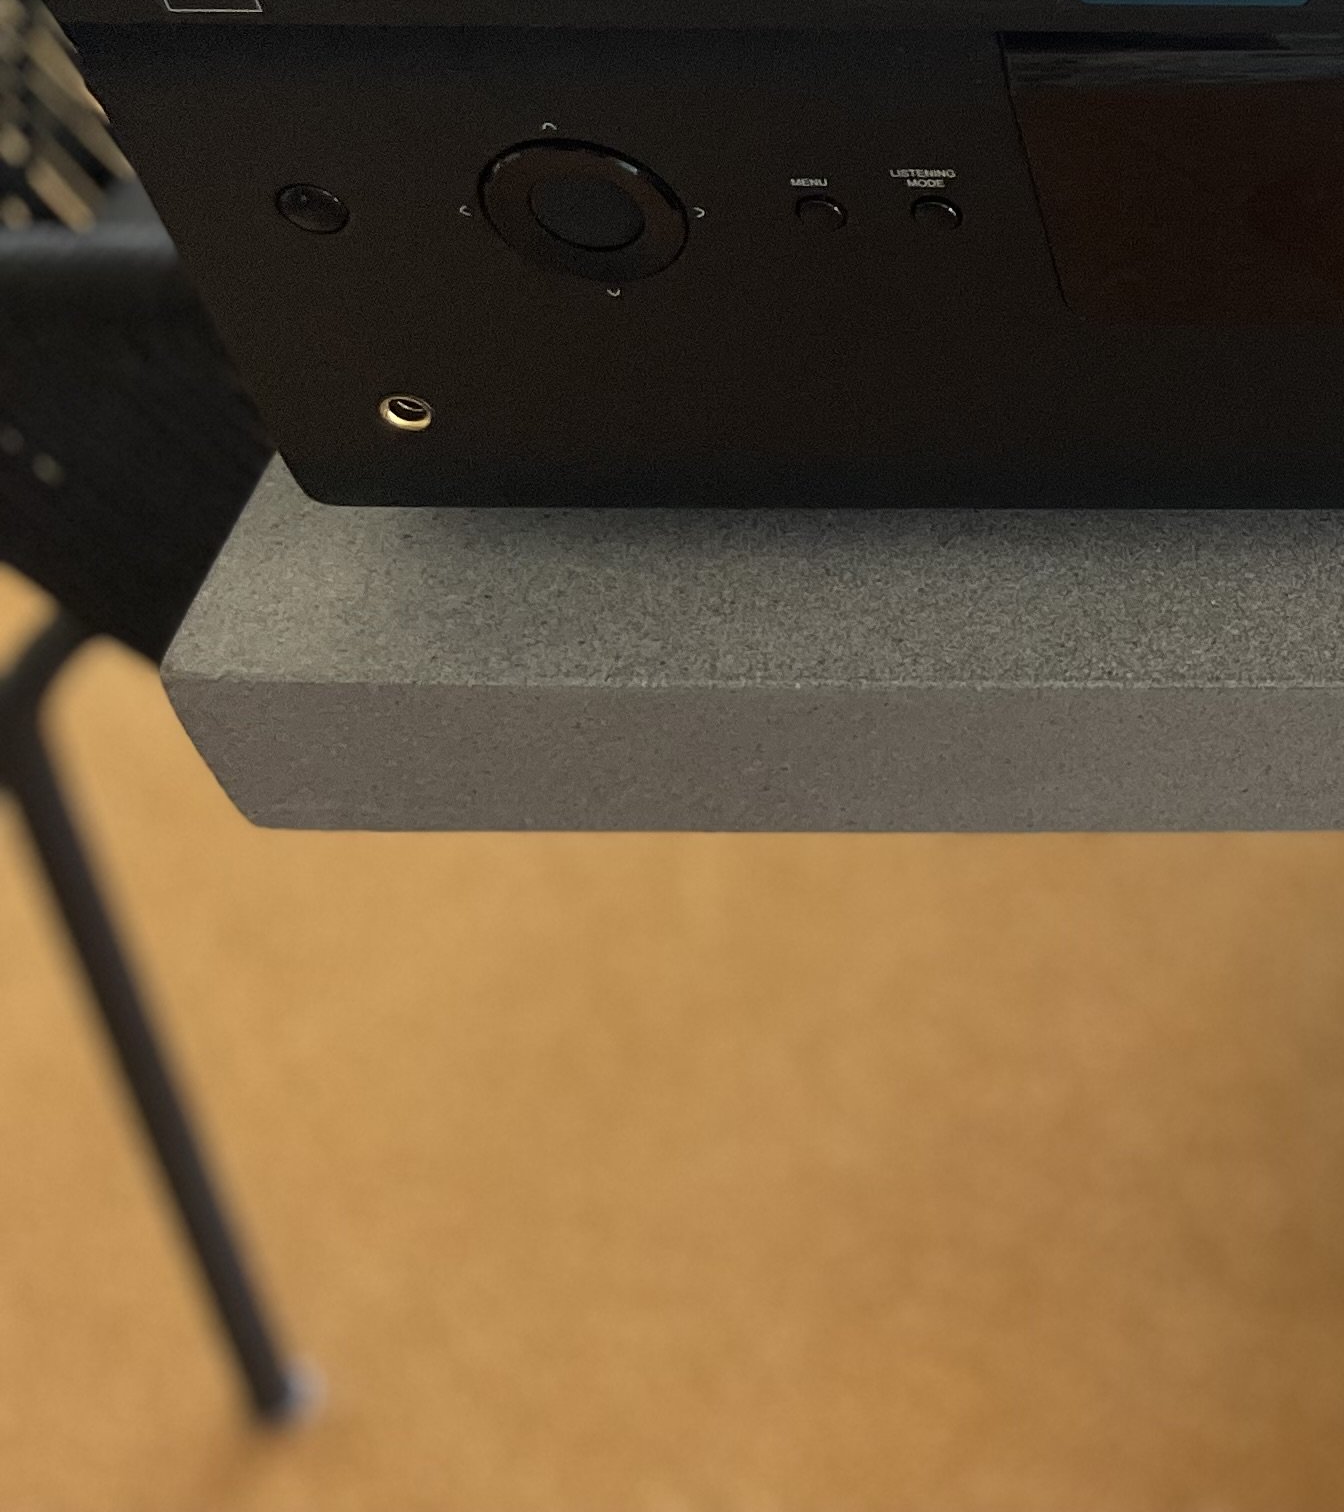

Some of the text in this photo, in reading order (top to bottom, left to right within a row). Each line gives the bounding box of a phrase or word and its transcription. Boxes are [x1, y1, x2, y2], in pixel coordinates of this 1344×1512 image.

[889, 169, 957, 179] LISTENING
[790, 178, 828, 187] MENU
[906, 179, 946, 188] MODE
